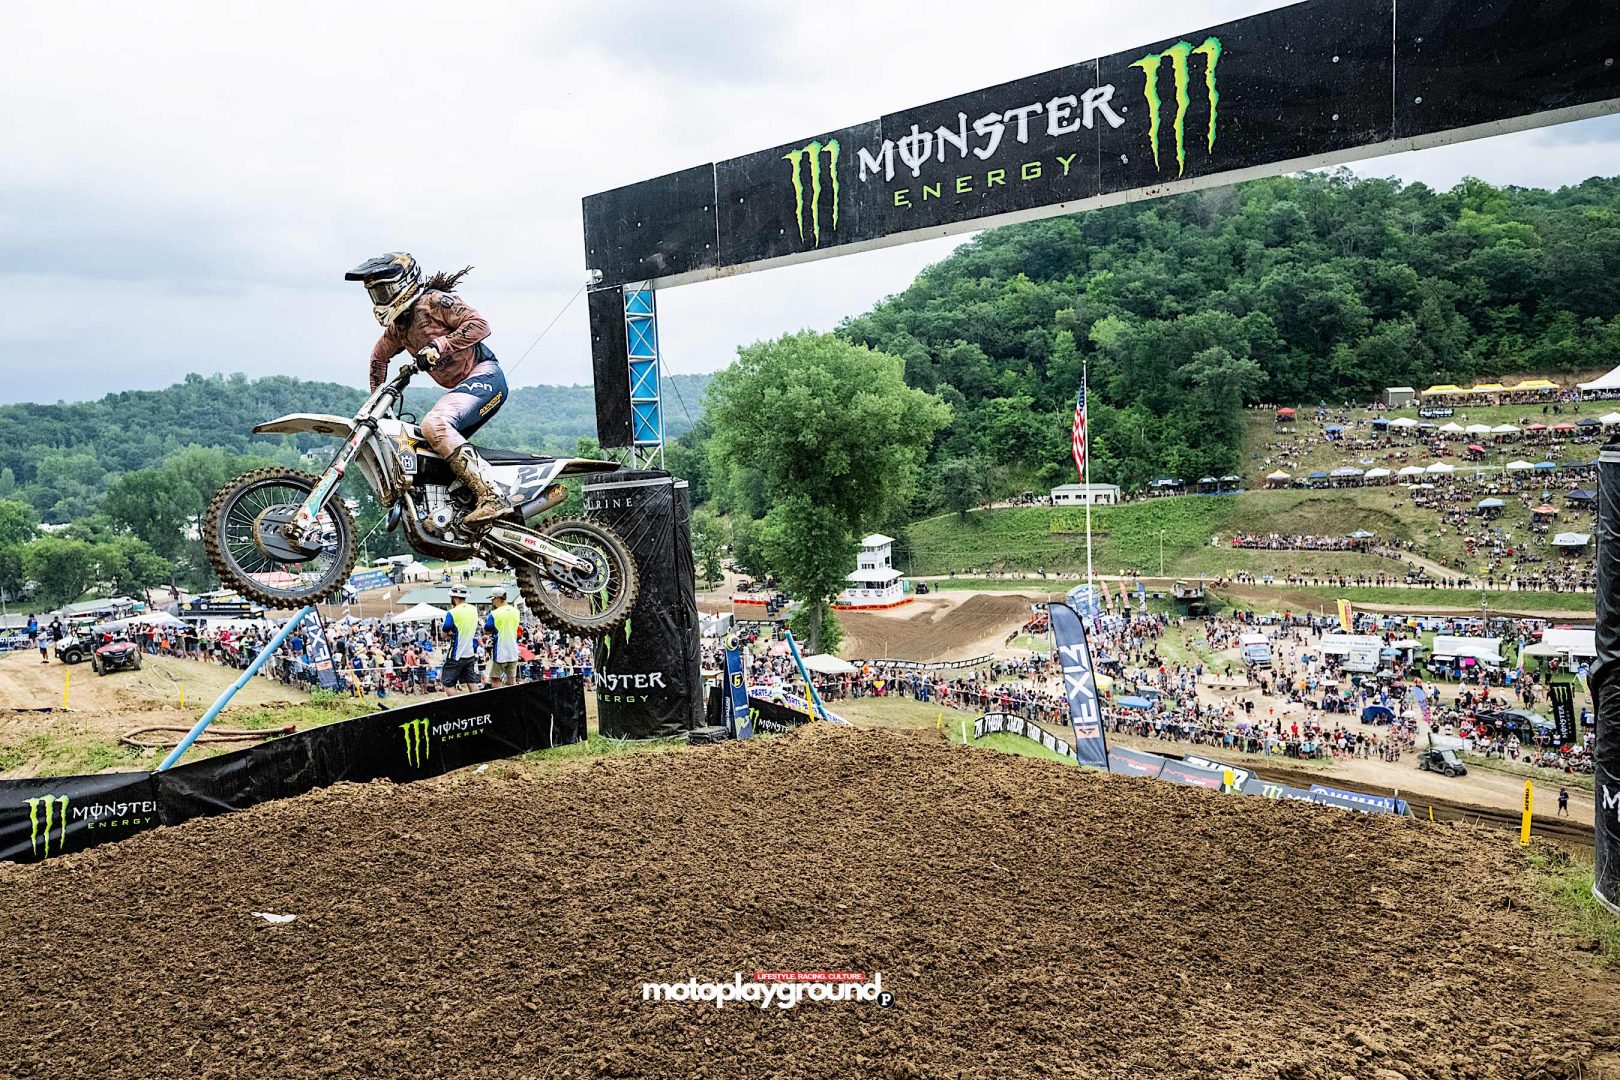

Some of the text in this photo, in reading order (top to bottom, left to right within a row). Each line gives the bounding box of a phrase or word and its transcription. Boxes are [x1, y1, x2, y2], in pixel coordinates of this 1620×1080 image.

[857, 83, 1126, 182] MONSTER
[893, 153, 1078, 207] ENERGY
[734, 678, 741, 688] 6
[432, 714, 492, 736] MONSTER
[441, 728, 485, 742] ENERGY
[87, 817, 151, 829] ENERGY
